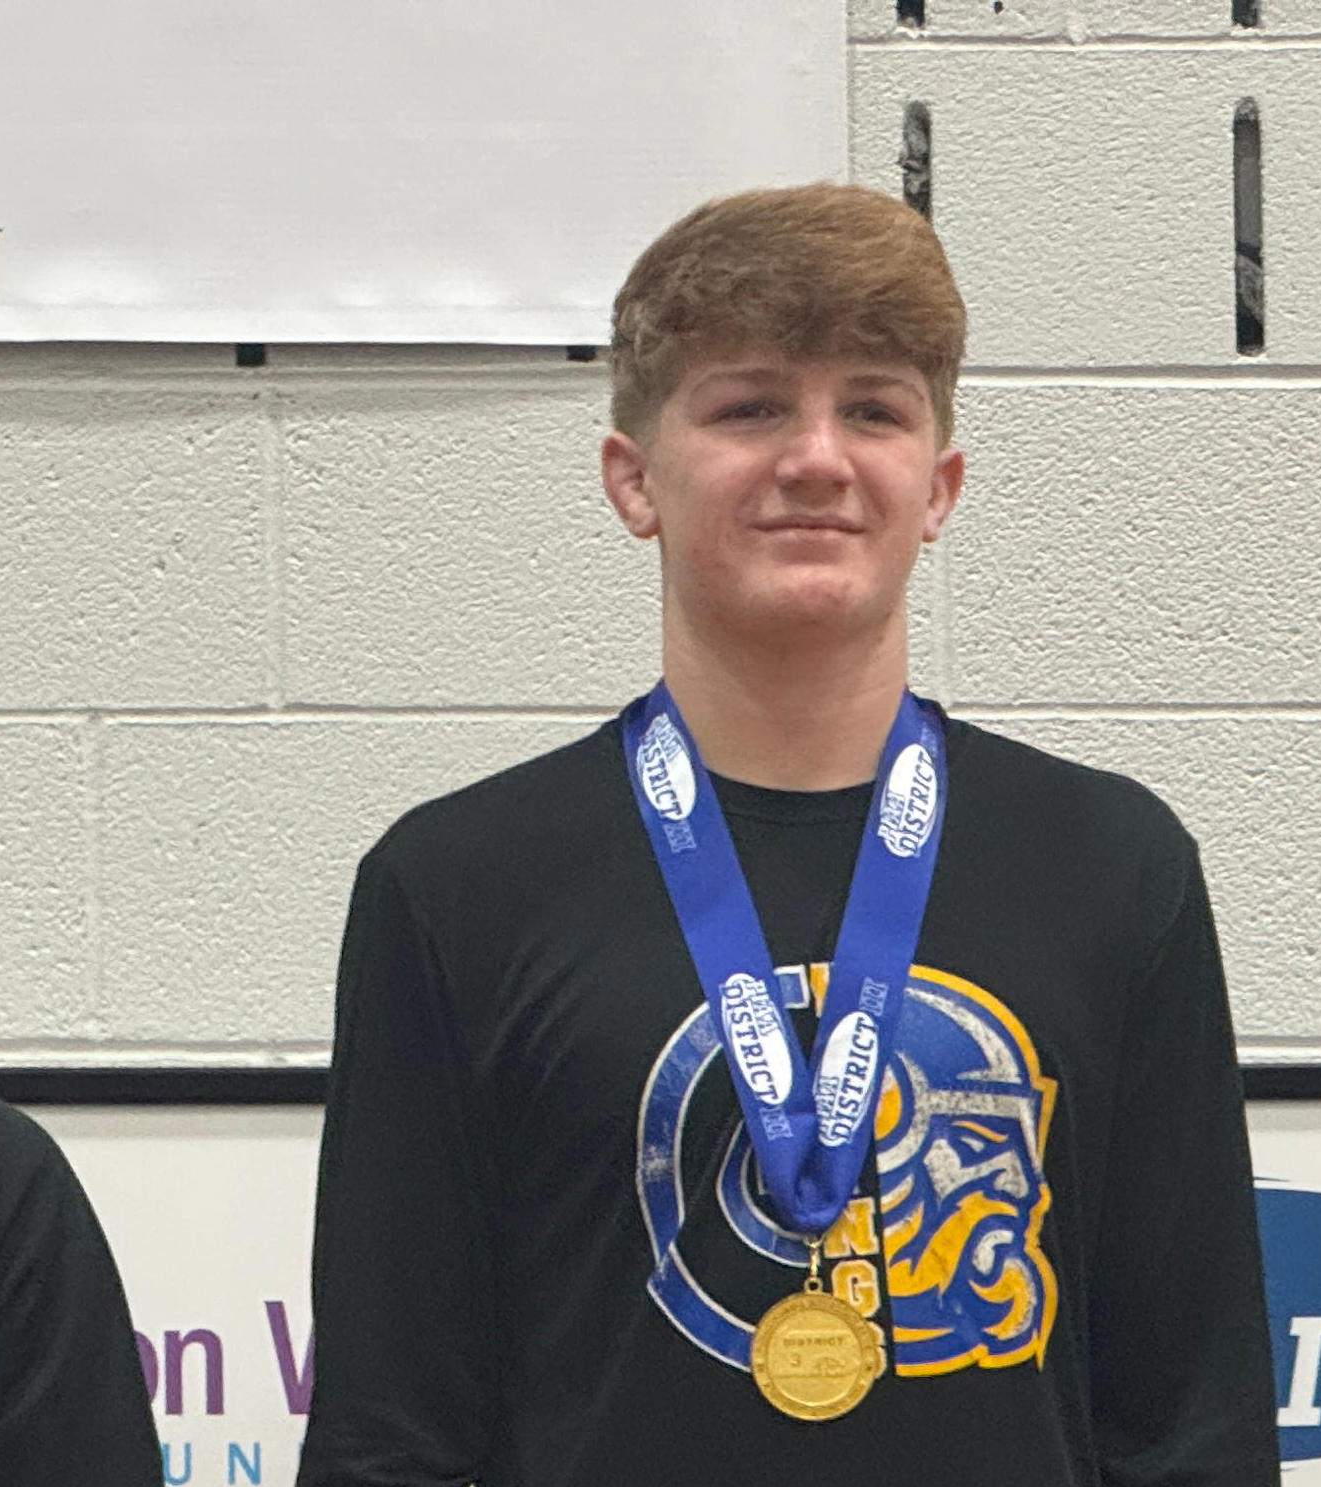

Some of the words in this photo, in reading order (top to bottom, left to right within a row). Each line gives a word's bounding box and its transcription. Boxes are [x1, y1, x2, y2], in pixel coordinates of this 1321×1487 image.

[899, 750, 936, 854] DISTRICT
[720, 982, 780, 1100] DISTRICT
[830, 1017, 878, 1141] DISTRICT
